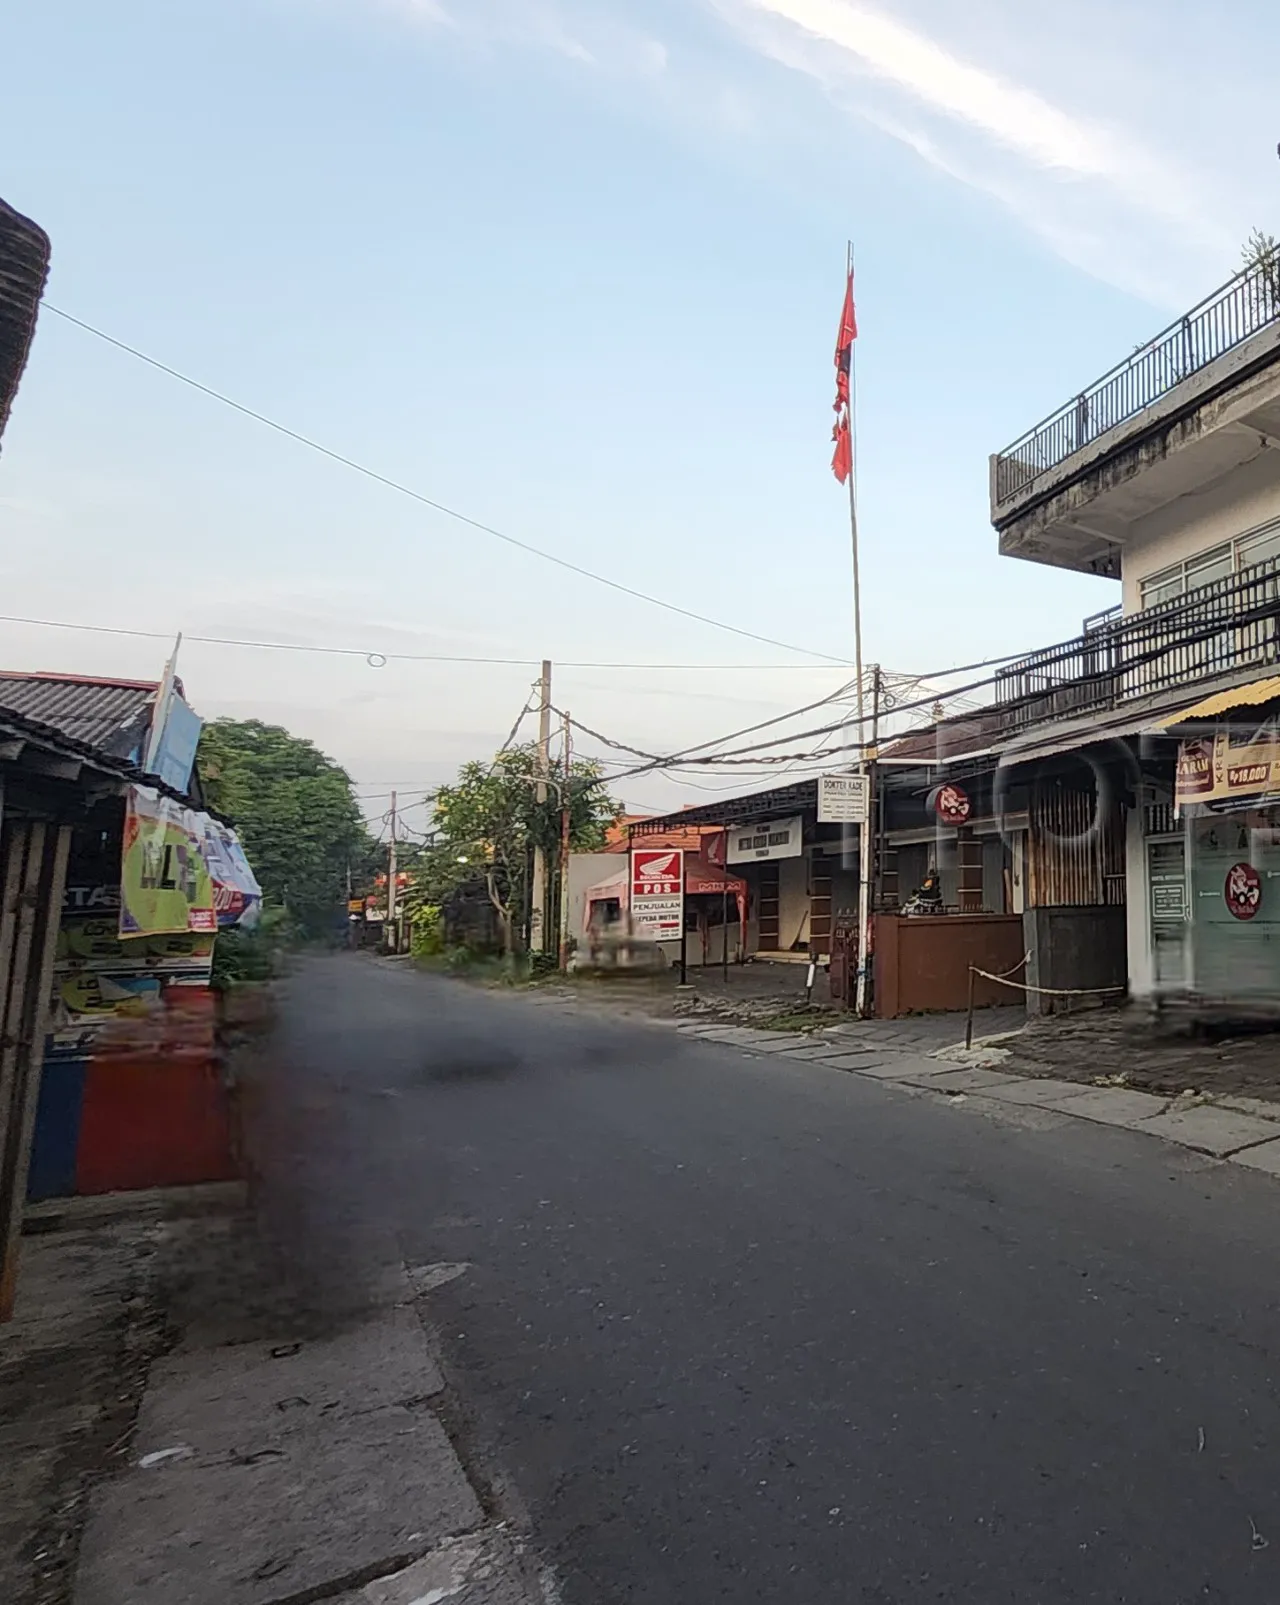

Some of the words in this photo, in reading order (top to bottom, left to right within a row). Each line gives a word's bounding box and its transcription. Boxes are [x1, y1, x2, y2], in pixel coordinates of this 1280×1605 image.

[823, 780, 847, 789] DOKTER
[643, 883, 672, 894] POS
[633, 902, 681, 910] PENJUALAN
